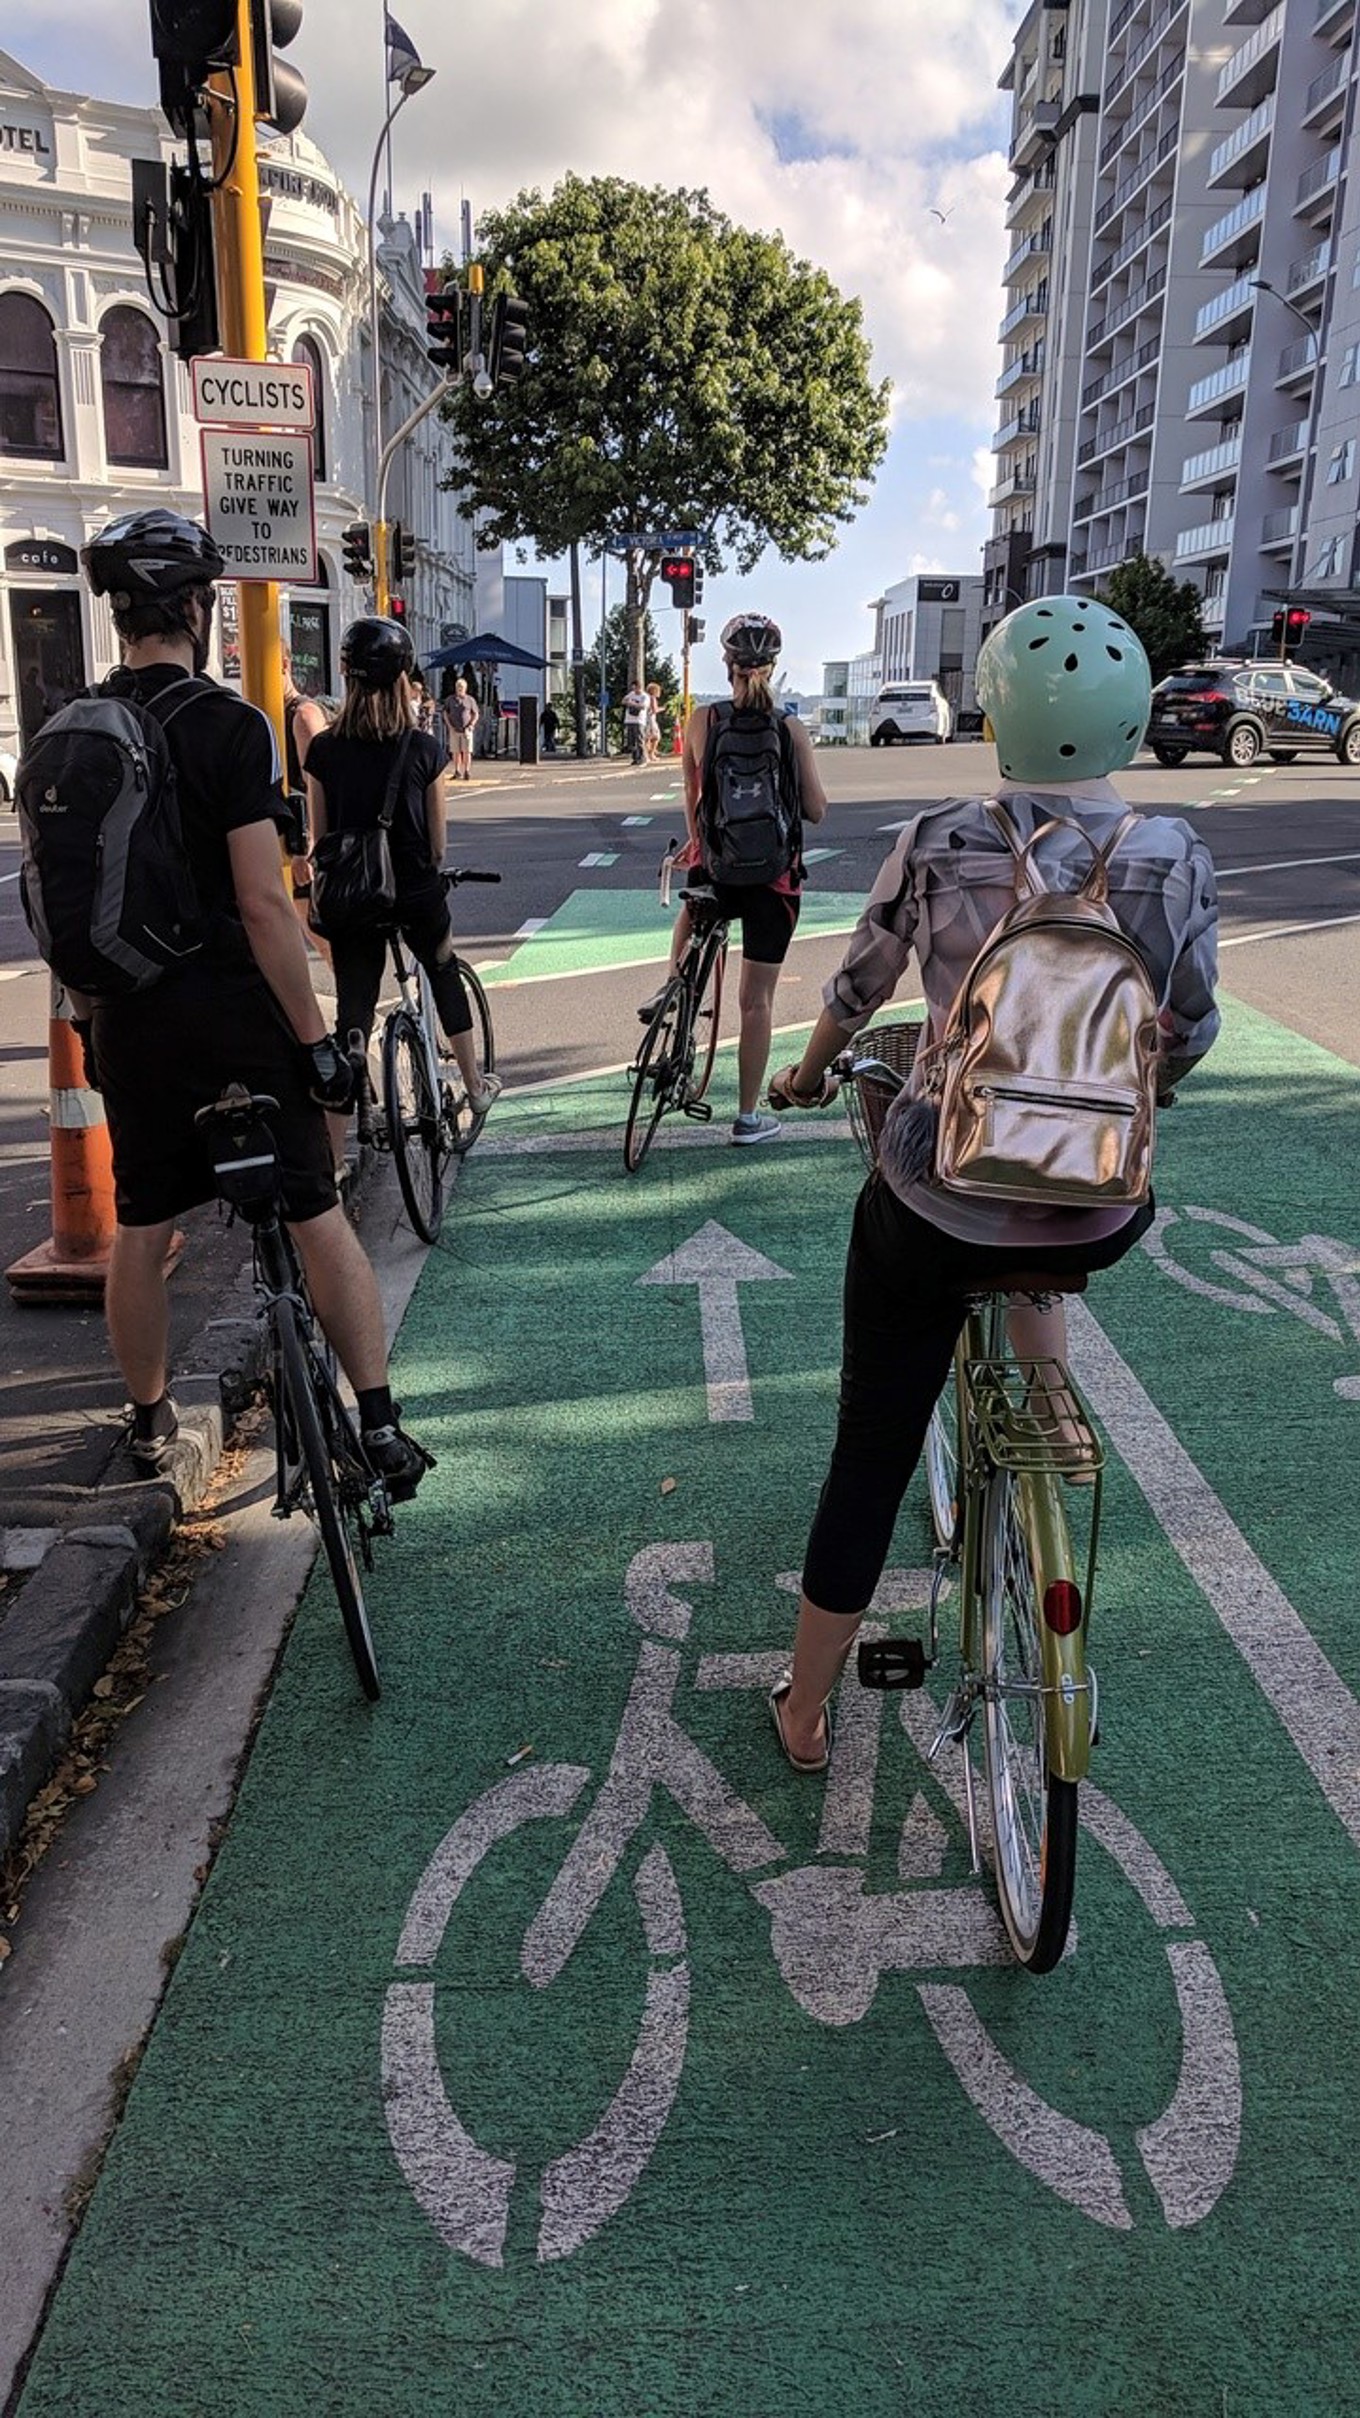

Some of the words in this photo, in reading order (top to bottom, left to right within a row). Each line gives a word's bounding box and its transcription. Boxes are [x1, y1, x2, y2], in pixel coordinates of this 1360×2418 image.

[0, 125, 50, 154] TEL
[201, 377, 305, 410] CYCLISTS
[221, 447, 294, 470] TURNING
[224, 472, 293, 494] TRAFFIC
[219, 496, 258, 516] GIVE
[267, 499, 299, 518] WAY
[251, 521, 272, 540] TO
